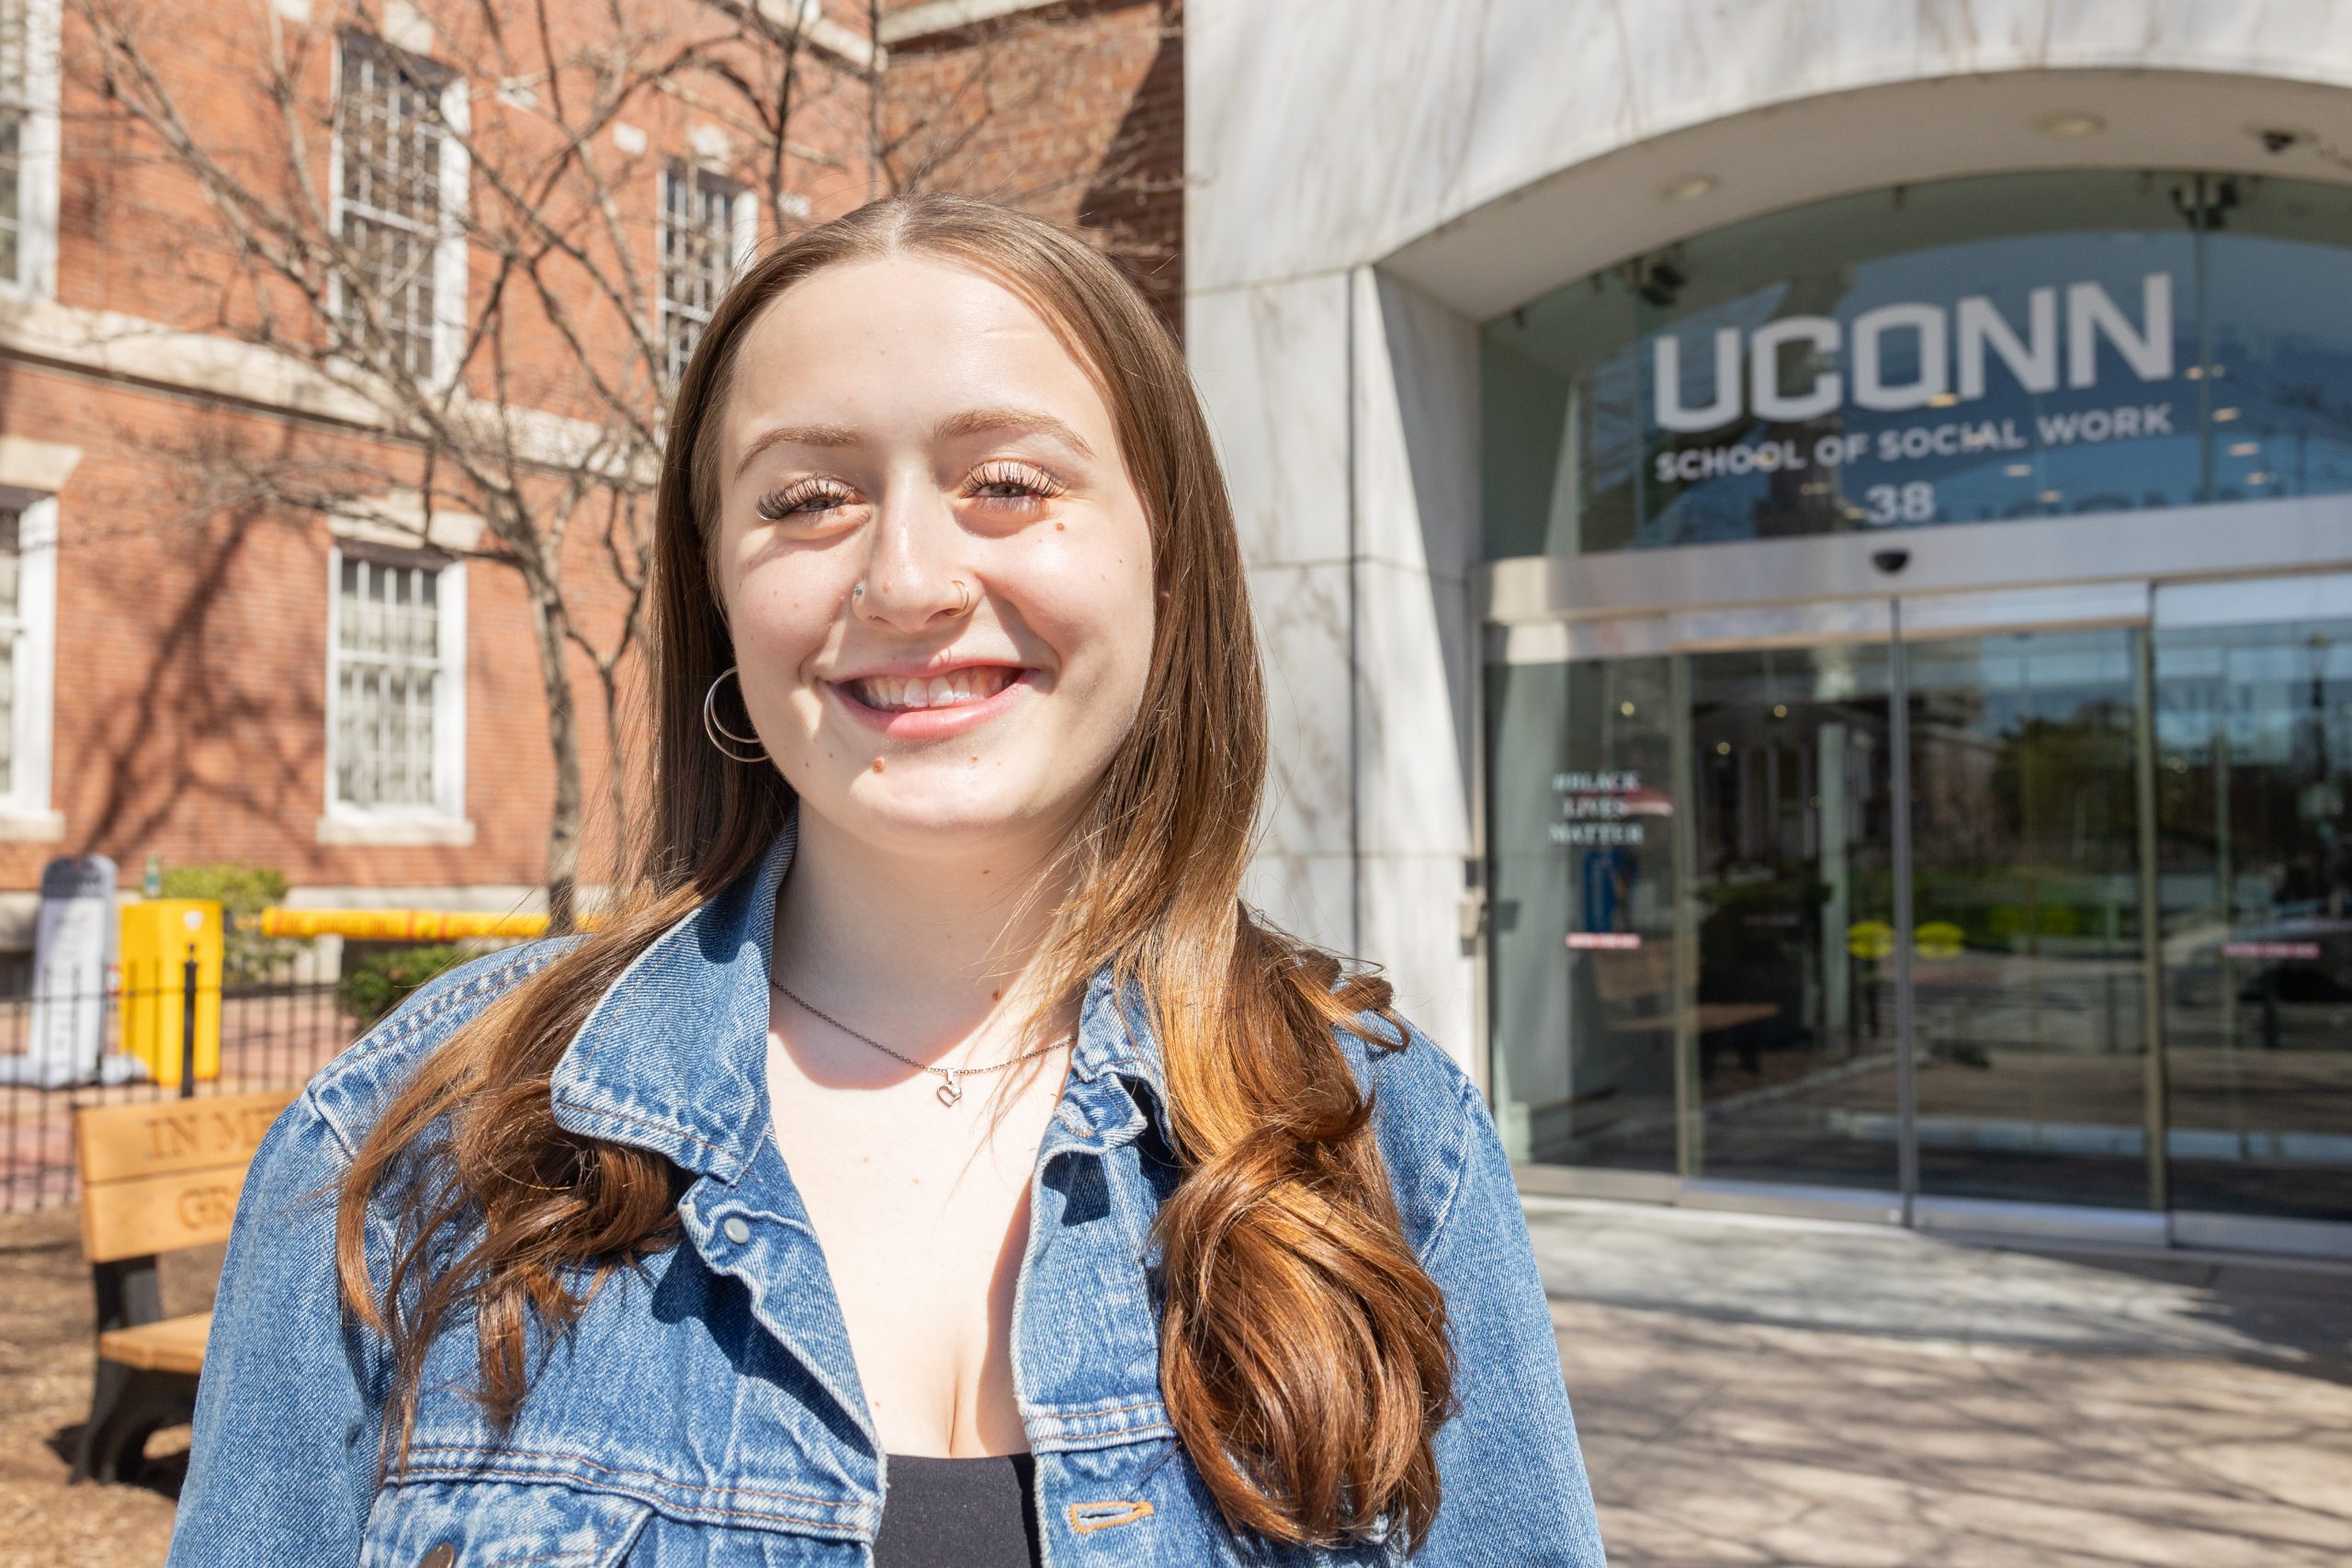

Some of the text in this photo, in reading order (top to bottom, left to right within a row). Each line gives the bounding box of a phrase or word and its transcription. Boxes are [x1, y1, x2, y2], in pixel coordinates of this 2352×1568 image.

[1654, 273, 2173, 432] UCONN
[1656, 402, 2174, 483] SCHOOL OF SOCIAL WORK
[1864, 480, 1936, 526] 38
[145, 1113, 199, 1160] IN
